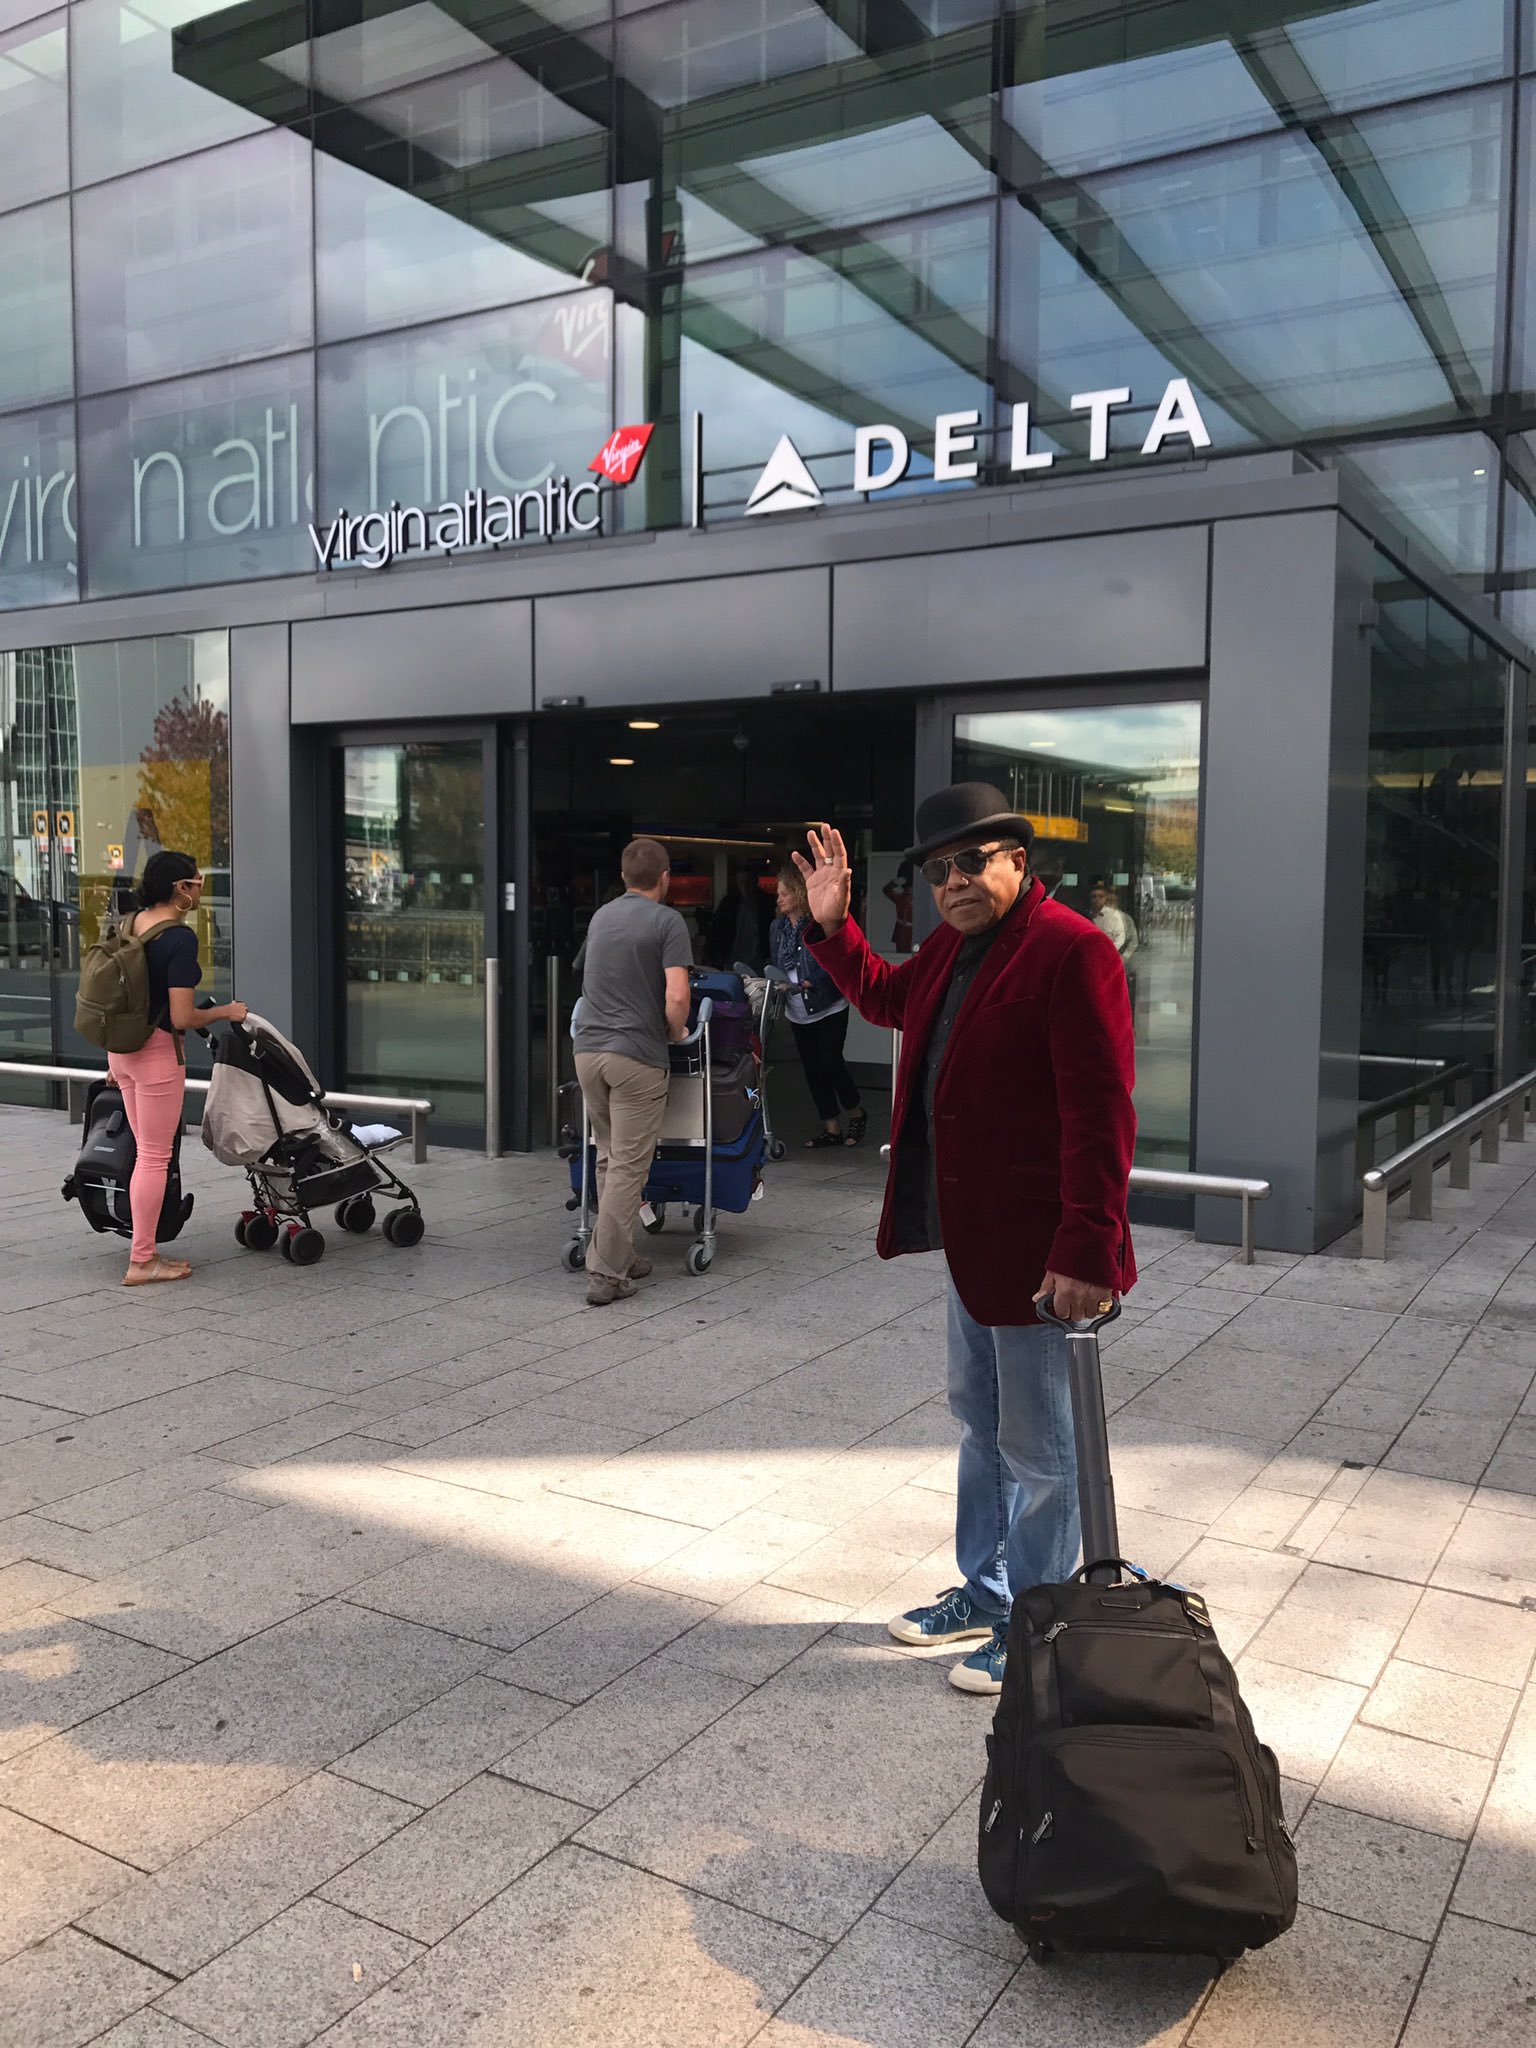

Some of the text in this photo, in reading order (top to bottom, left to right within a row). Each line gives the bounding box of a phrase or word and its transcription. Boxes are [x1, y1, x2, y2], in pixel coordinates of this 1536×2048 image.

[602, 432, 643, 474] Virgin
[854, 378, 1212, 492] DELTA
[308, 475, 601, 570] virgin atlantic
